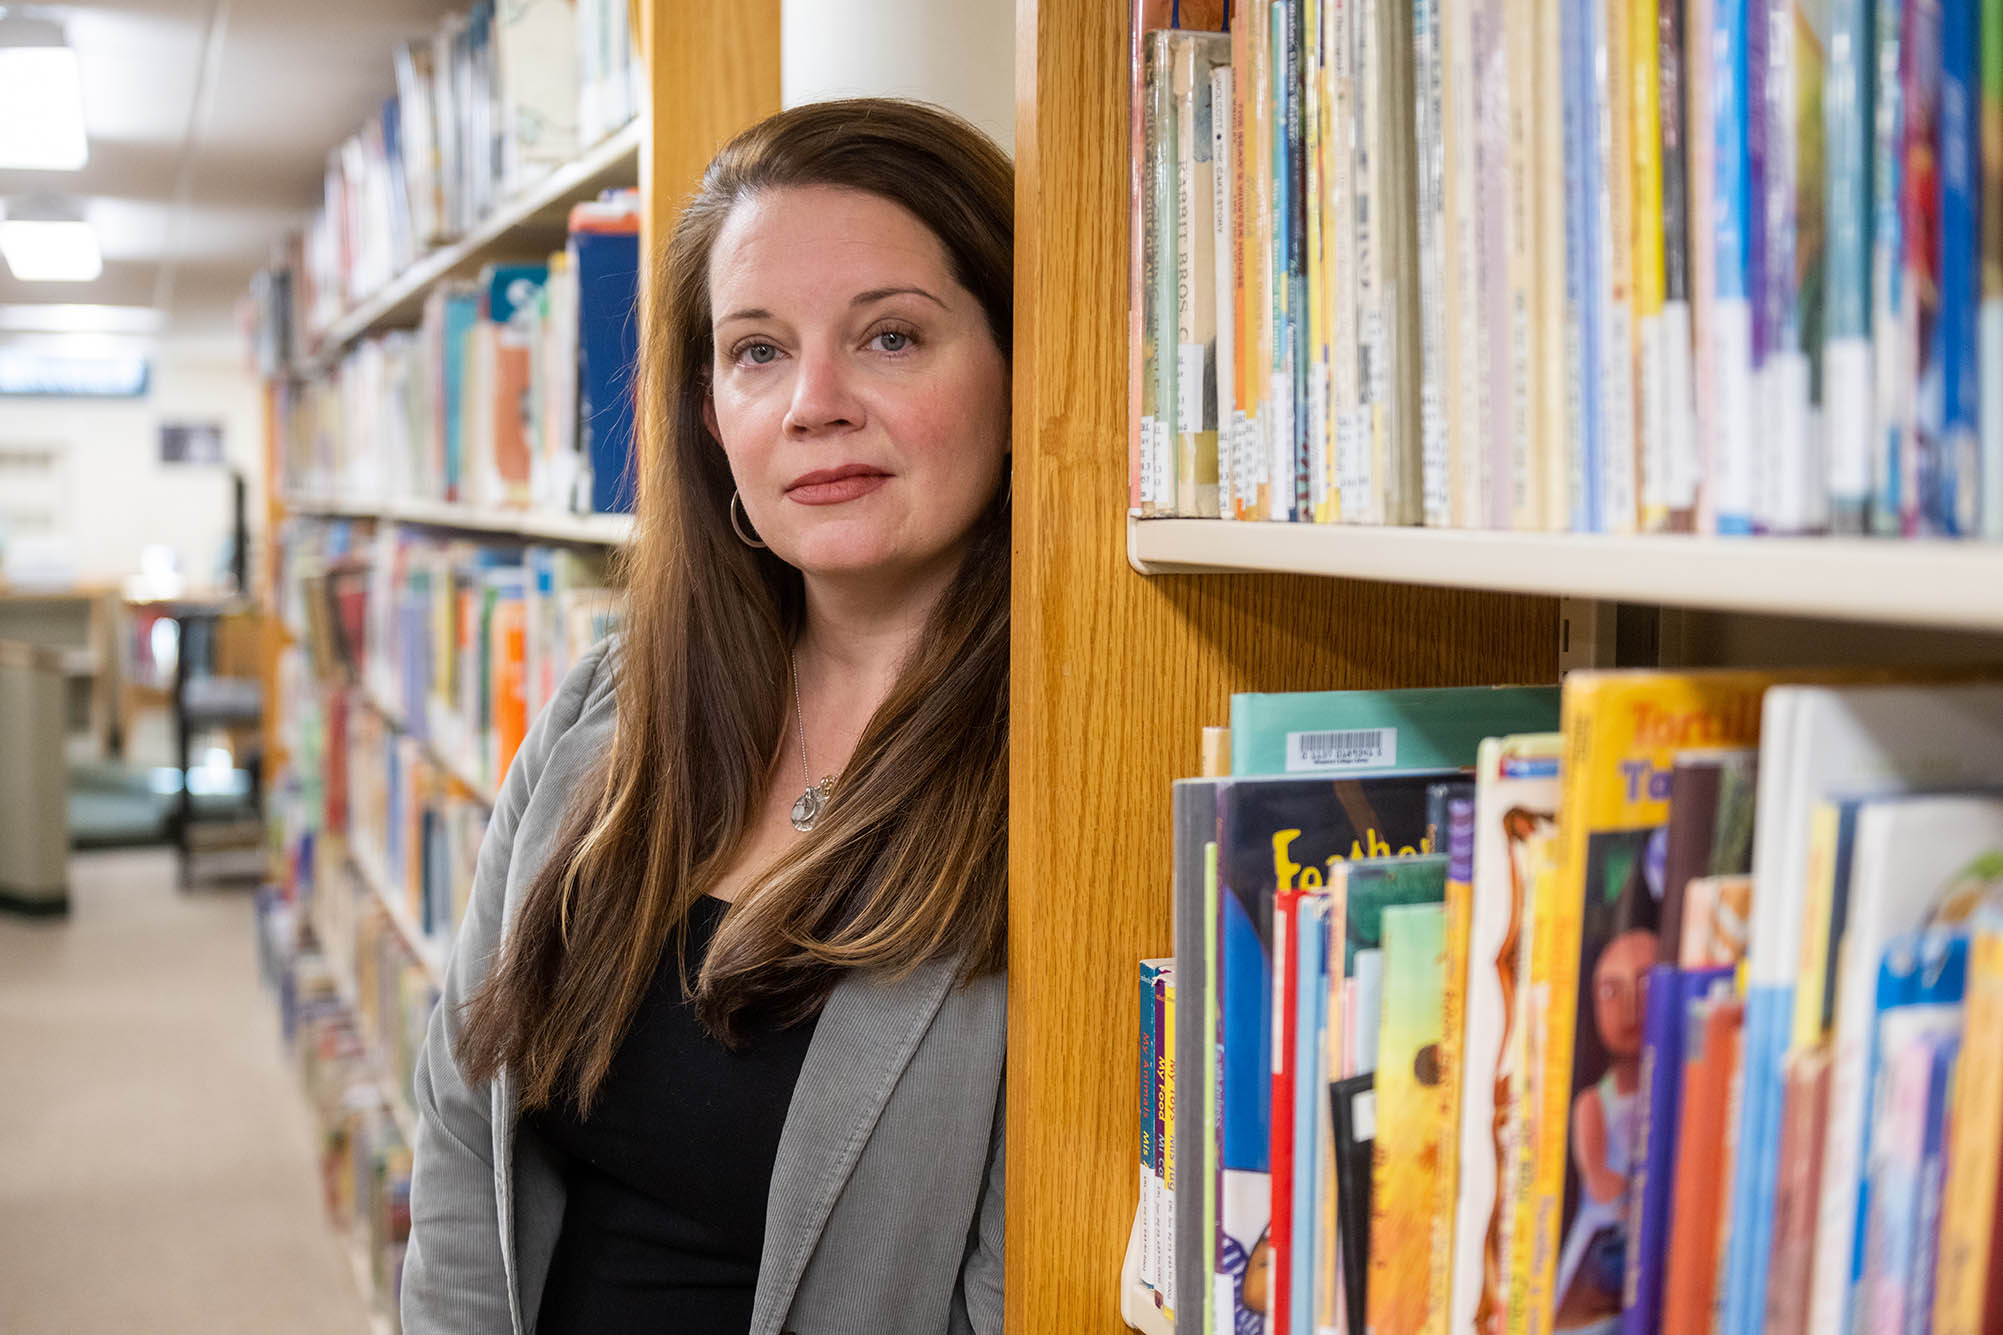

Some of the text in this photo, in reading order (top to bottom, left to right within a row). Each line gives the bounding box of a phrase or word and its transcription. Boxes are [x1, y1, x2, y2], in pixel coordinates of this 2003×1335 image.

[1215, 143, 1223, 161] THE
[1215, 166, 1223, 195] CAKE
[1146, 161, 1154, 227] TORTOISE
[1215, 198, 1223, 234] STORY
[1146, 236, 1153, 254] OF
[1142, 1032, 1151, 1054] My
[1157, 1056, 1166, 1080] My
[1167, 1059, 1176, 1082] My
[1142, 1058, 1151, 1118] Animals
[1157, 1084, 1166, 1121] Food
[1167, 1088, 1176, 1121] Toys
[1142, 1131, 1151, 1154] Mis
[1157, 1133, 1166, 1152] Mi
